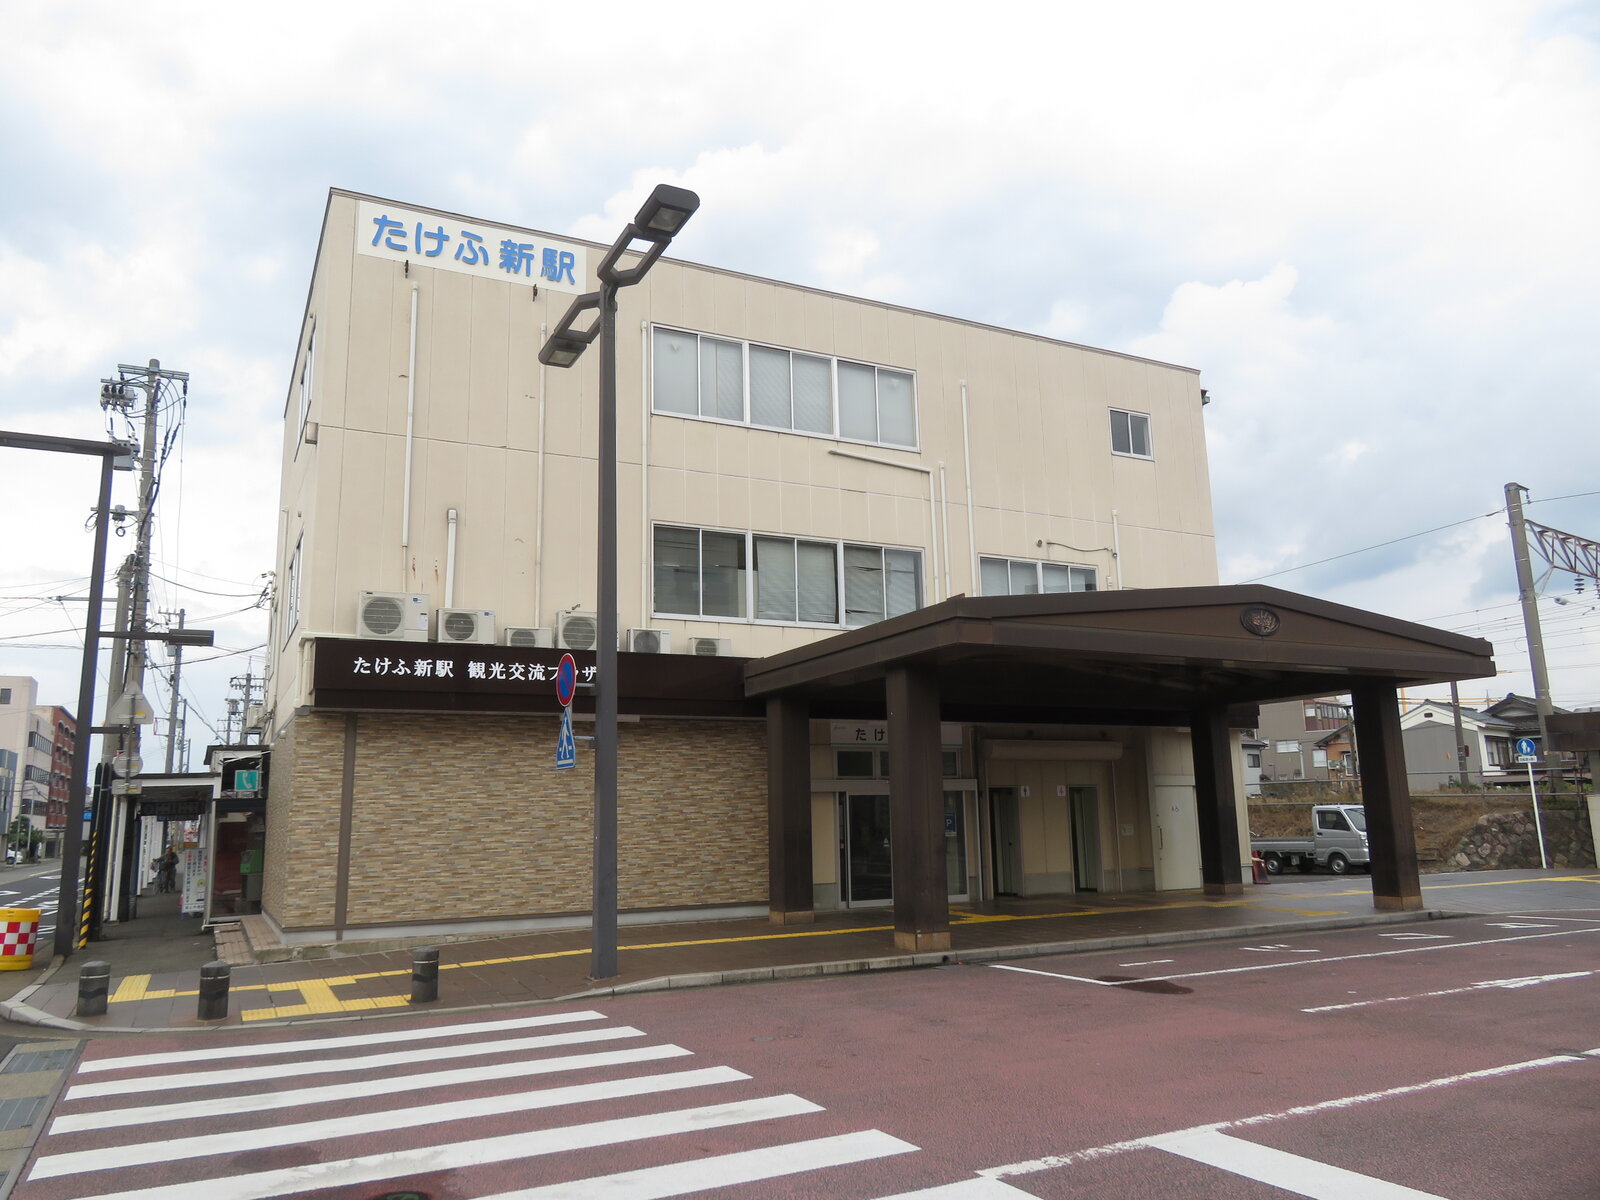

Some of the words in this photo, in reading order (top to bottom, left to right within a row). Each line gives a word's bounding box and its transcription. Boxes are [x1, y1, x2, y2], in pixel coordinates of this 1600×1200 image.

[372, 214, 576, 285] たけふ新駅
[353, 656, 455, 678] たけふ新駅
[468, 660, 597, 682] 観光交流プザ
